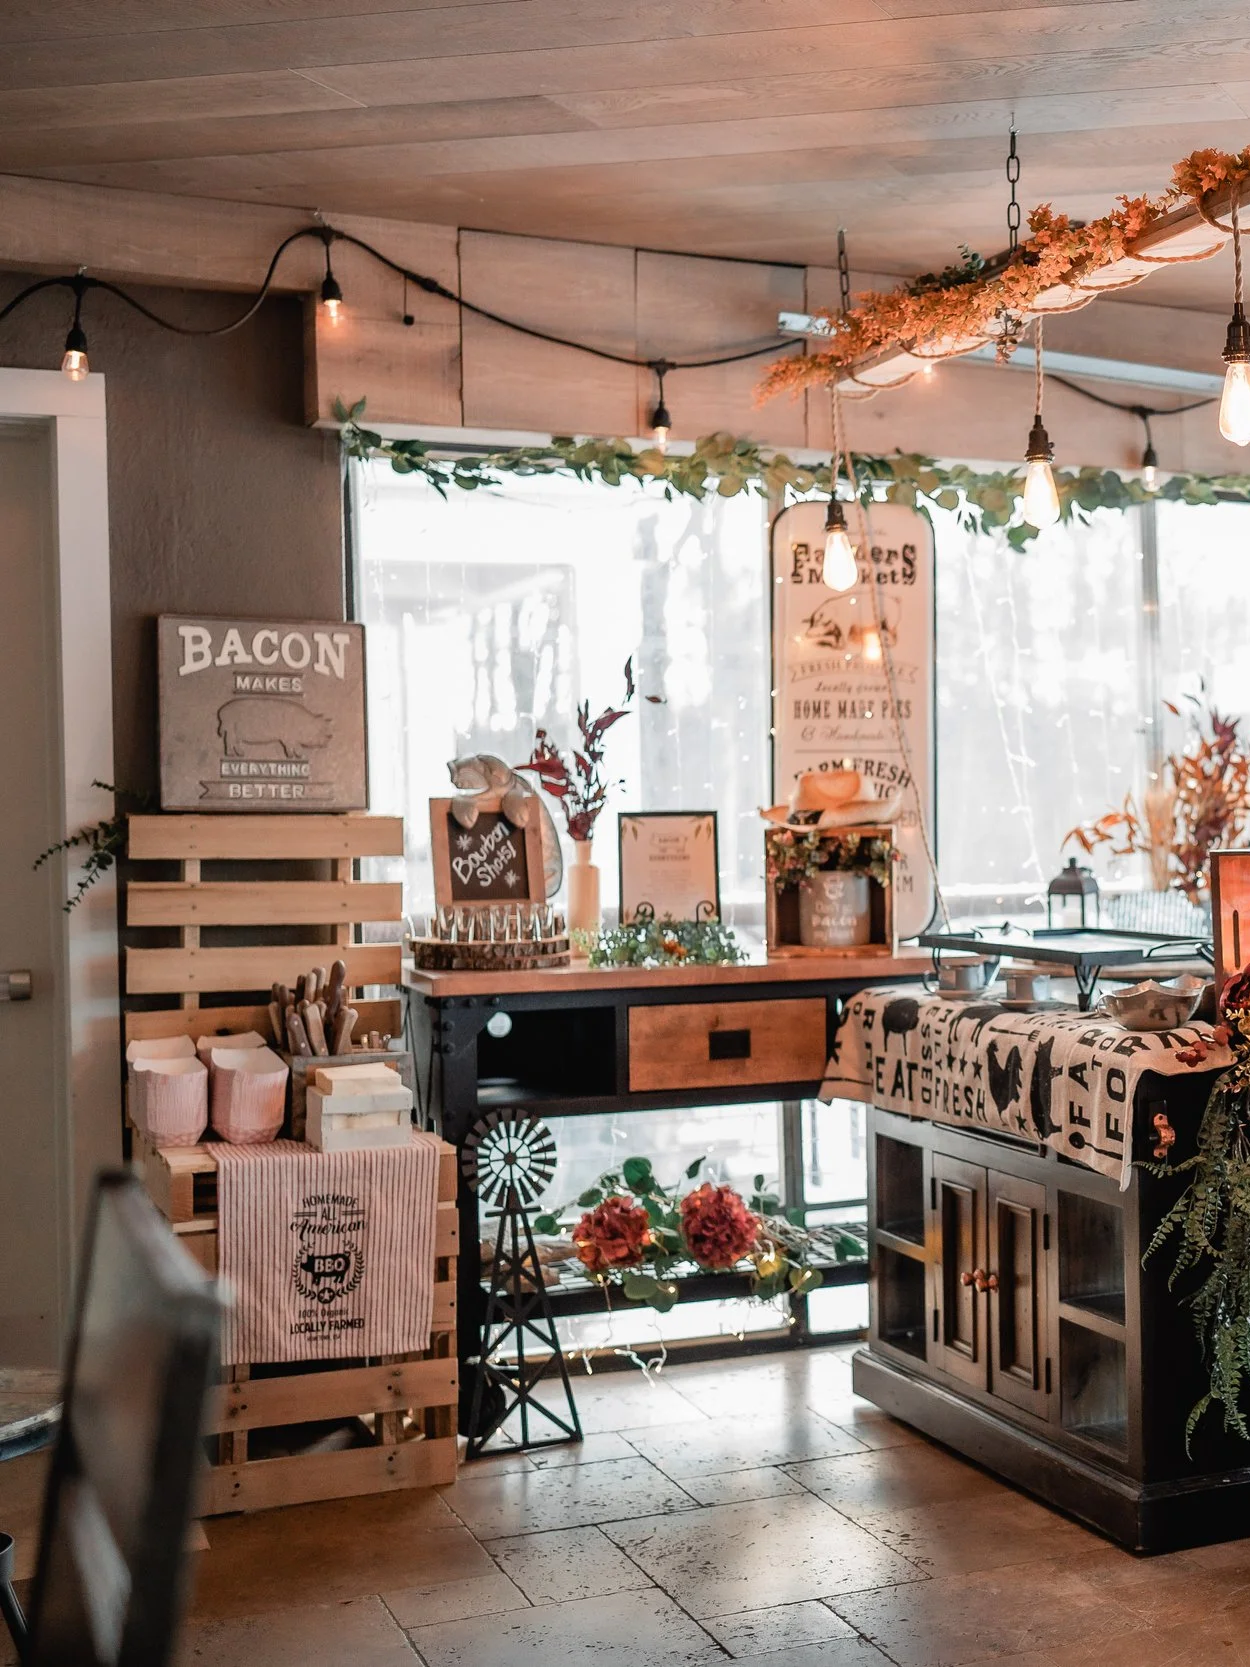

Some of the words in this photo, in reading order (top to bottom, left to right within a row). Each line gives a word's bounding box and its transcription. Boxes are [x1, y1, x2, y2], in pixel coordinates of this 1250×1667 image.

[178, 625, 350, 679] BACON
[236, 675, 303, 692] MAKES
[793, 699, 831, 719] HOME
[838, 699, 875, 720] MADE
[881, 699, 912, 719] PIES
[221, 763, 310, 776] EVERYTHING
[853, 757, 912, 788] FRESH
[229, 783, 305, 799] BETTER
[452, 821, 510, 885] Bourbon
[477, 840, 517, 887] Shots!
[876, 1056, 918, 1101] EAT
[934, 1077, 988, 1123] FRESH
[302, 1192, 359, 1208] HOMEMADE
[321, 1206, 336, 1220] ALL
[290, 1218, 366, 1241] American
[314, 1257, 346, 1272] BBQ
[290, 1321, 326, 1334] LOCALLY
[329, 1318, 365, 1331] FARMED
